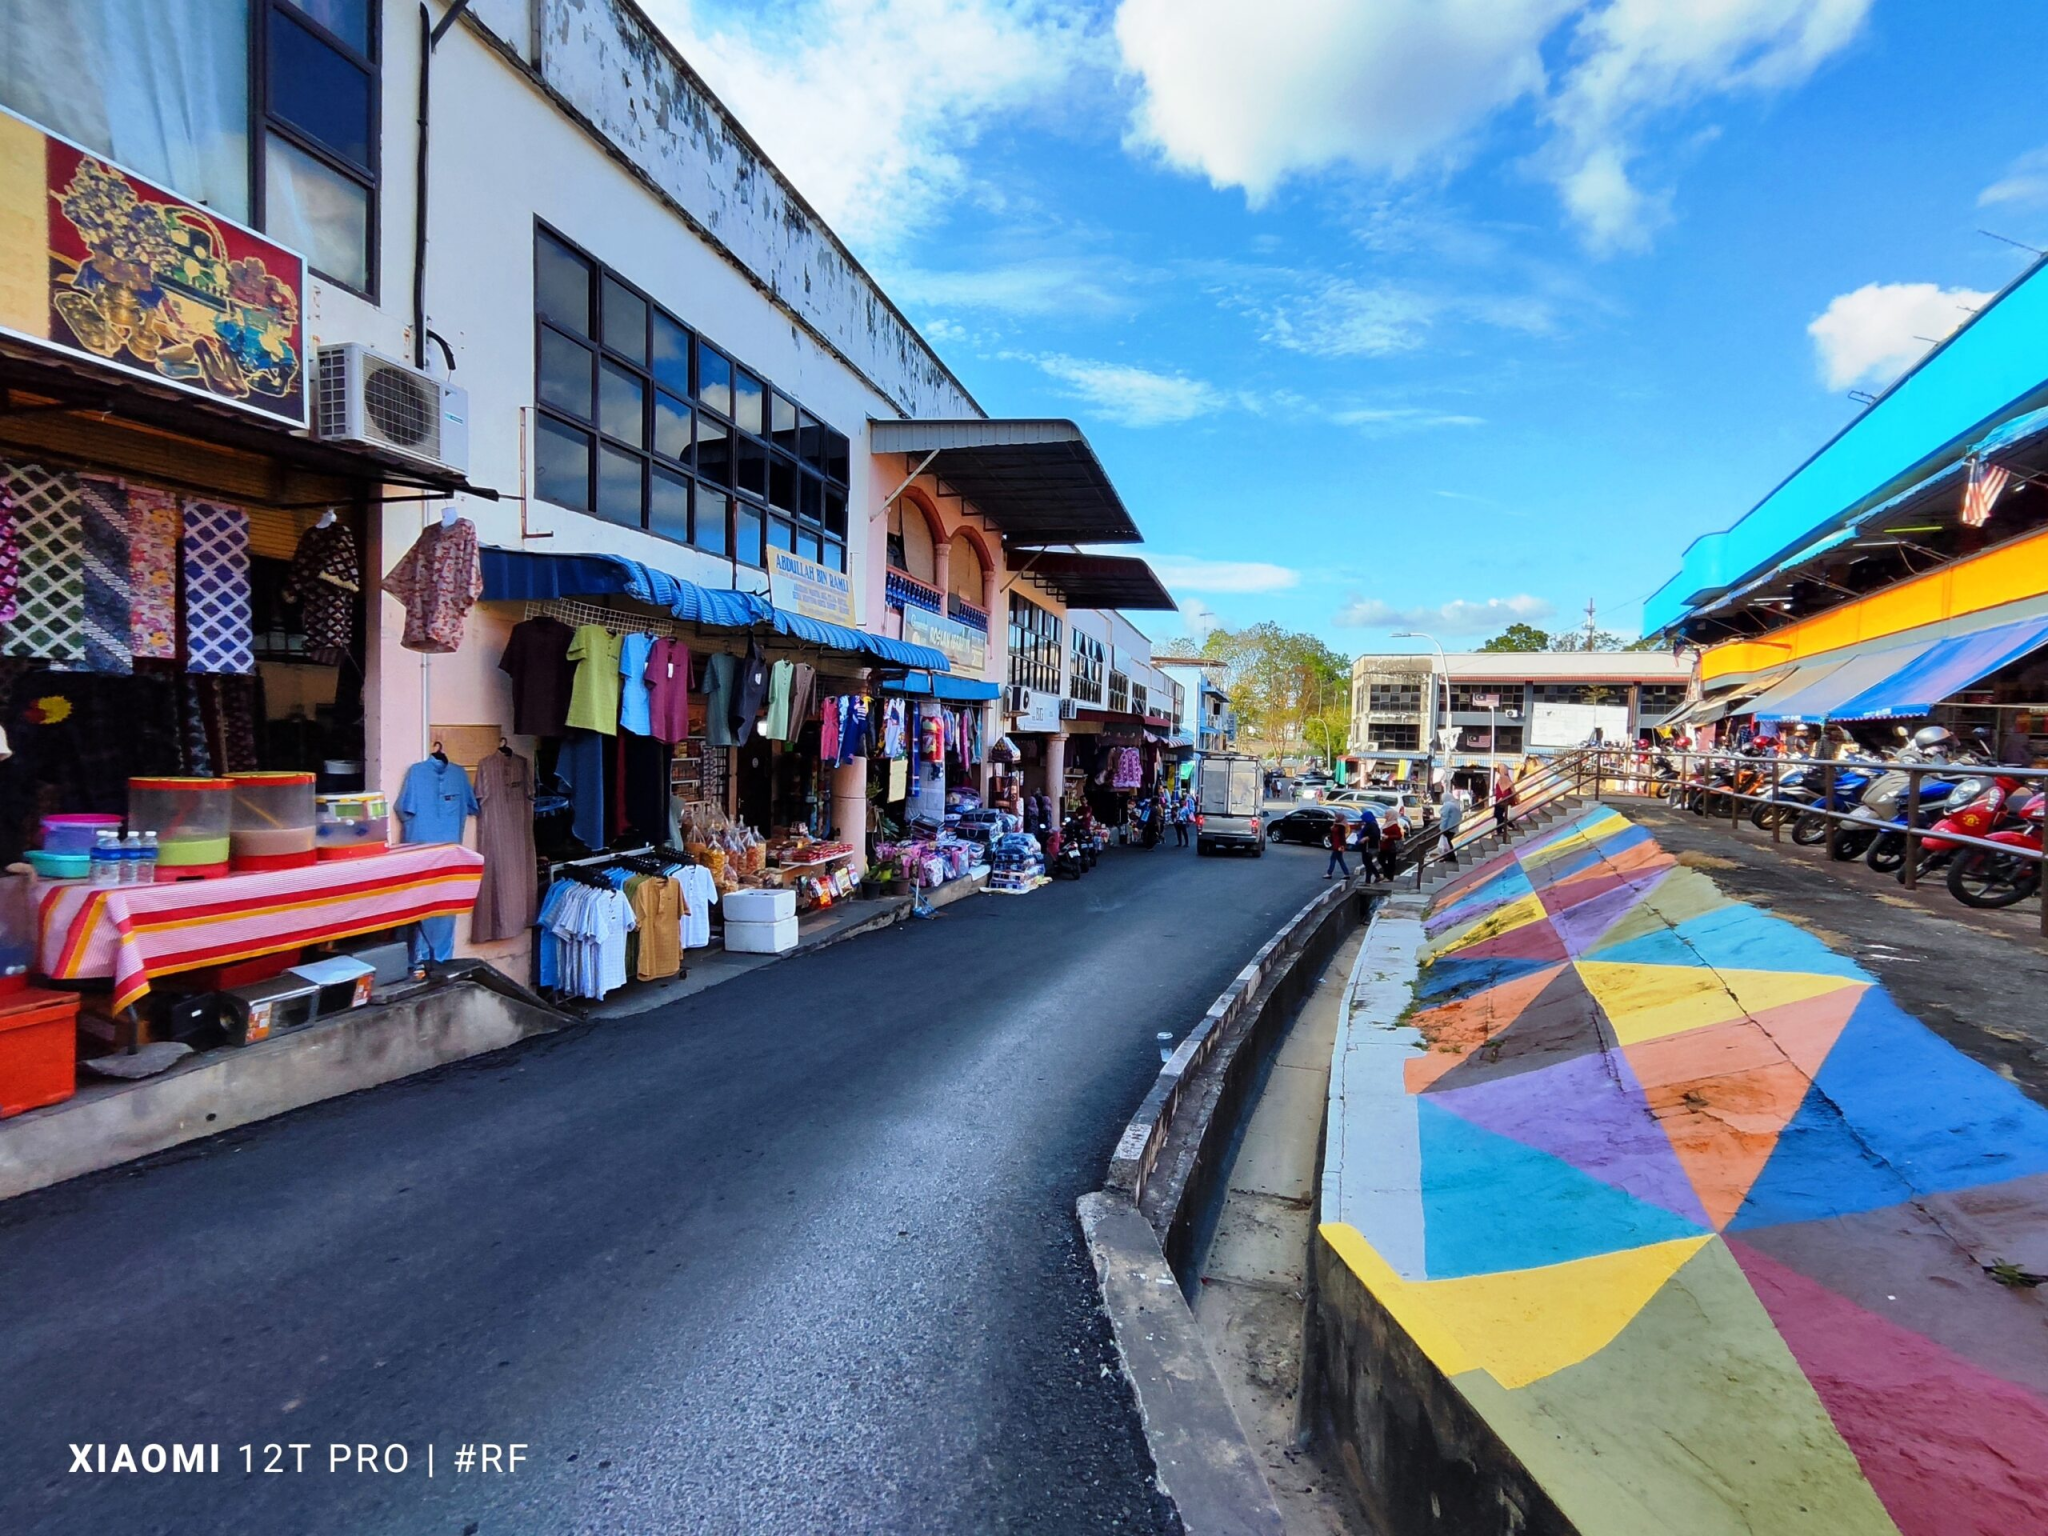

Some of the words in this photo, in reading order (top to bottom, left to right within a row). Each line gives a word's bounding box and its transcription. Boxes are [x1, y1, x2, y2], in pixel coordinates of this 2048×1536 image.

[776, 554, 815, 581] ABDULLAH
[816, 568, 828, 585] BIN
[829, 574, 849, 592] RAMLI
